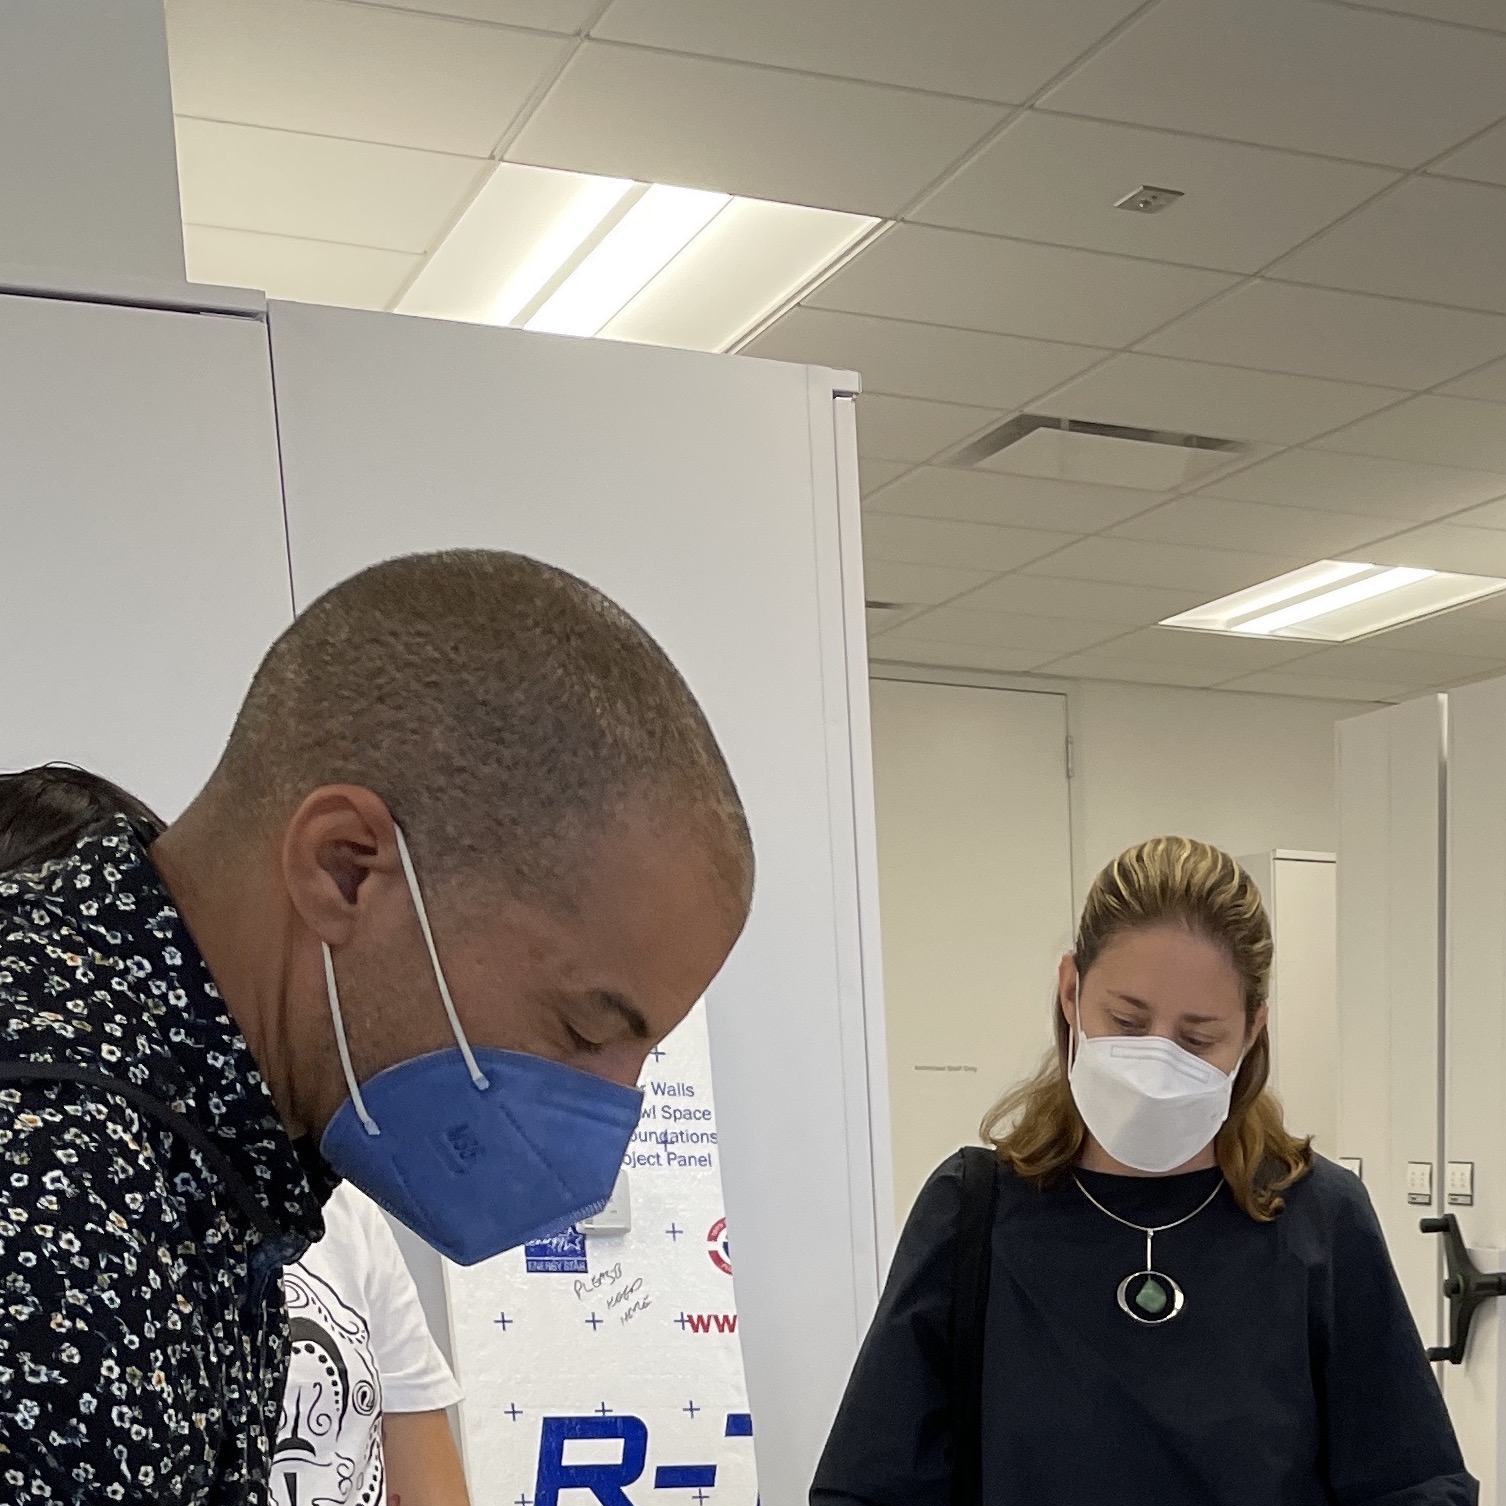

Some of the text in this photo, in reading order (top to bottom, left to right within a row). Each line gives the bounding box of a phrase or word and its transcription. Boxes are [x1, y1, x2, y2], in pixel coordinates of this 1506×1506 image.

[650, 1081, 695, 1097] Walls
[661, 1105, 712, 1123] Space
[630, 1129, 718, 1144] oundations
[623, 1151, 713, 1168] oject Panel
